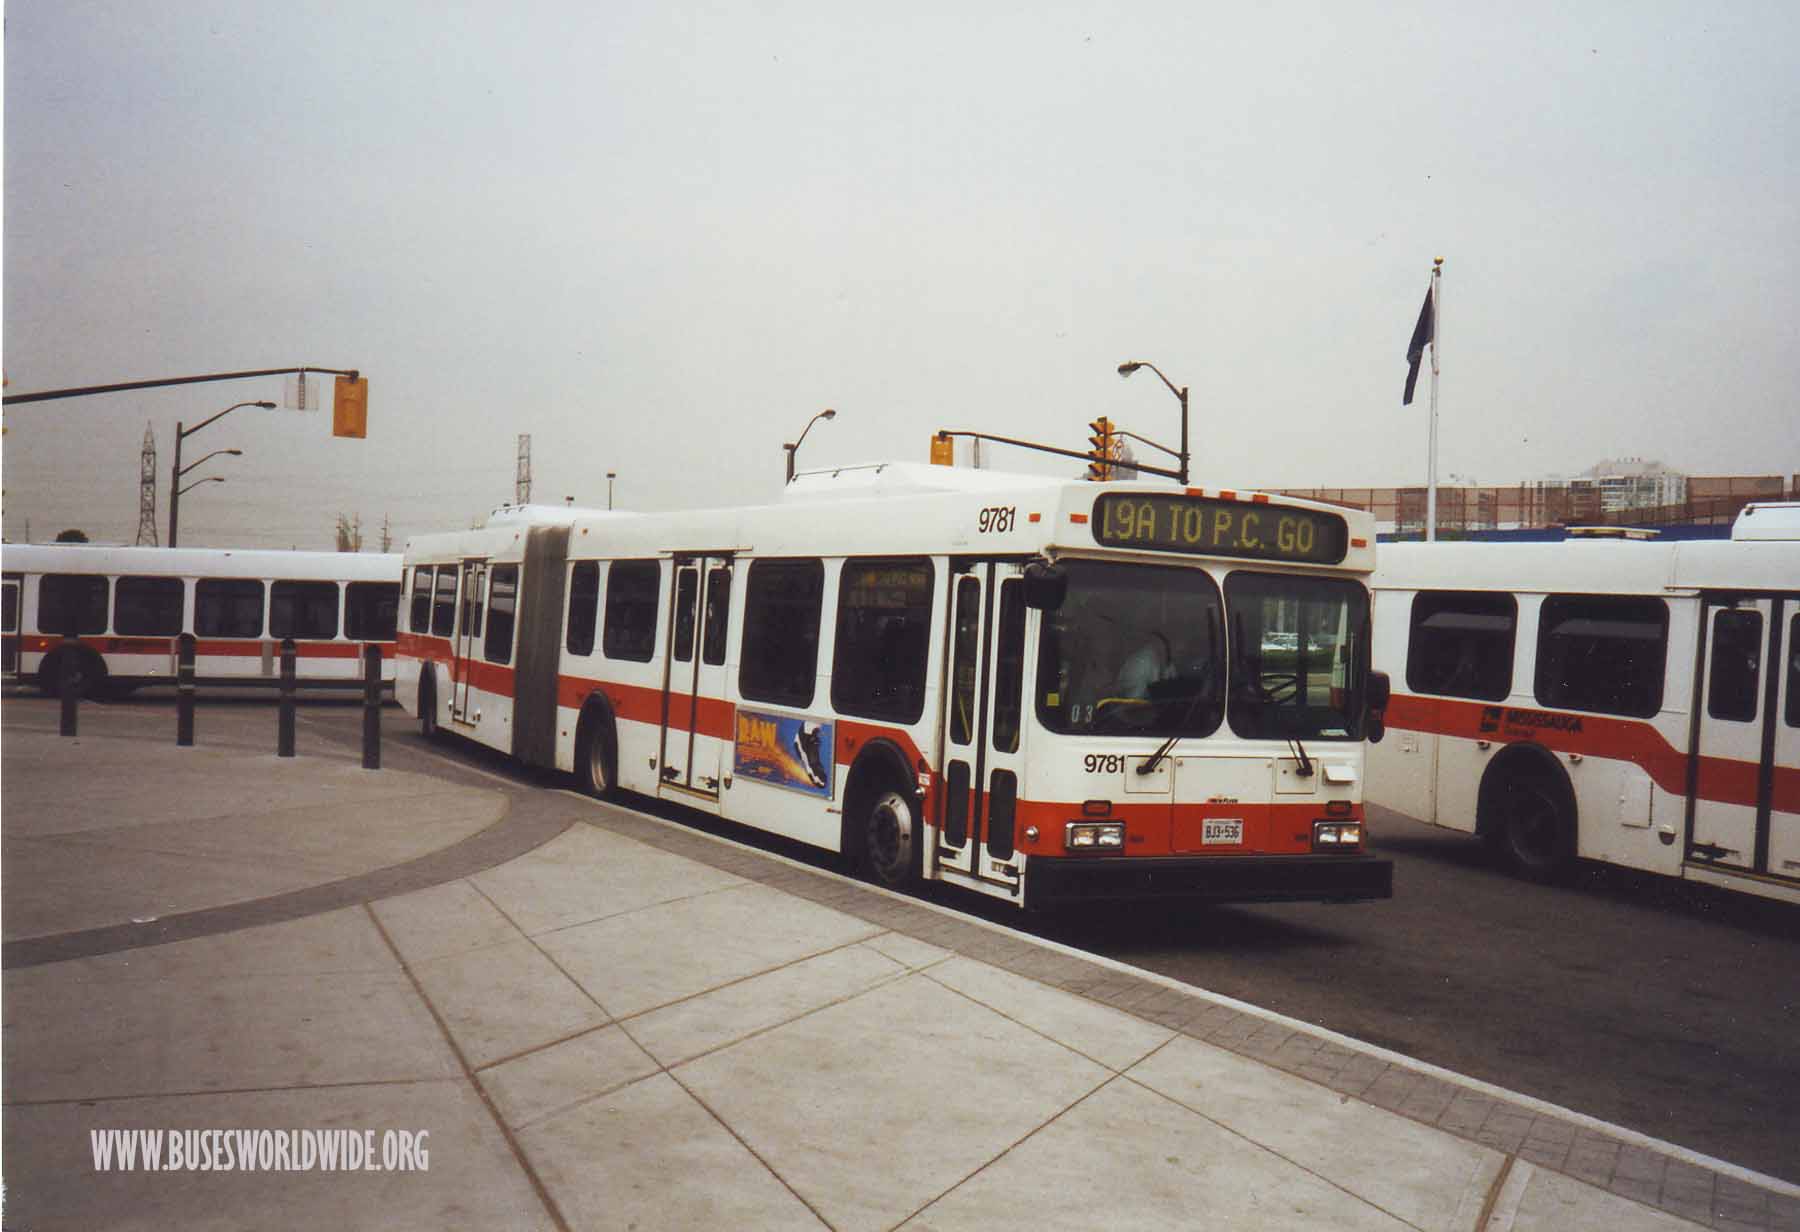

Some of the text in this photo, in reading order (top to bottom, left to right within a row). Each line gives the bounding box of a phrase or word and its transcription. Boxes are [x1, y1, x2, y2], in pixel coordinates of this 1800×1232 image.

[978, 506, 1016, 533] 9781
[1170, 504, 1201, 543] TO
[1278, 515, 1313, 552] GO
[1084, 754, 1126, 774] 9781
